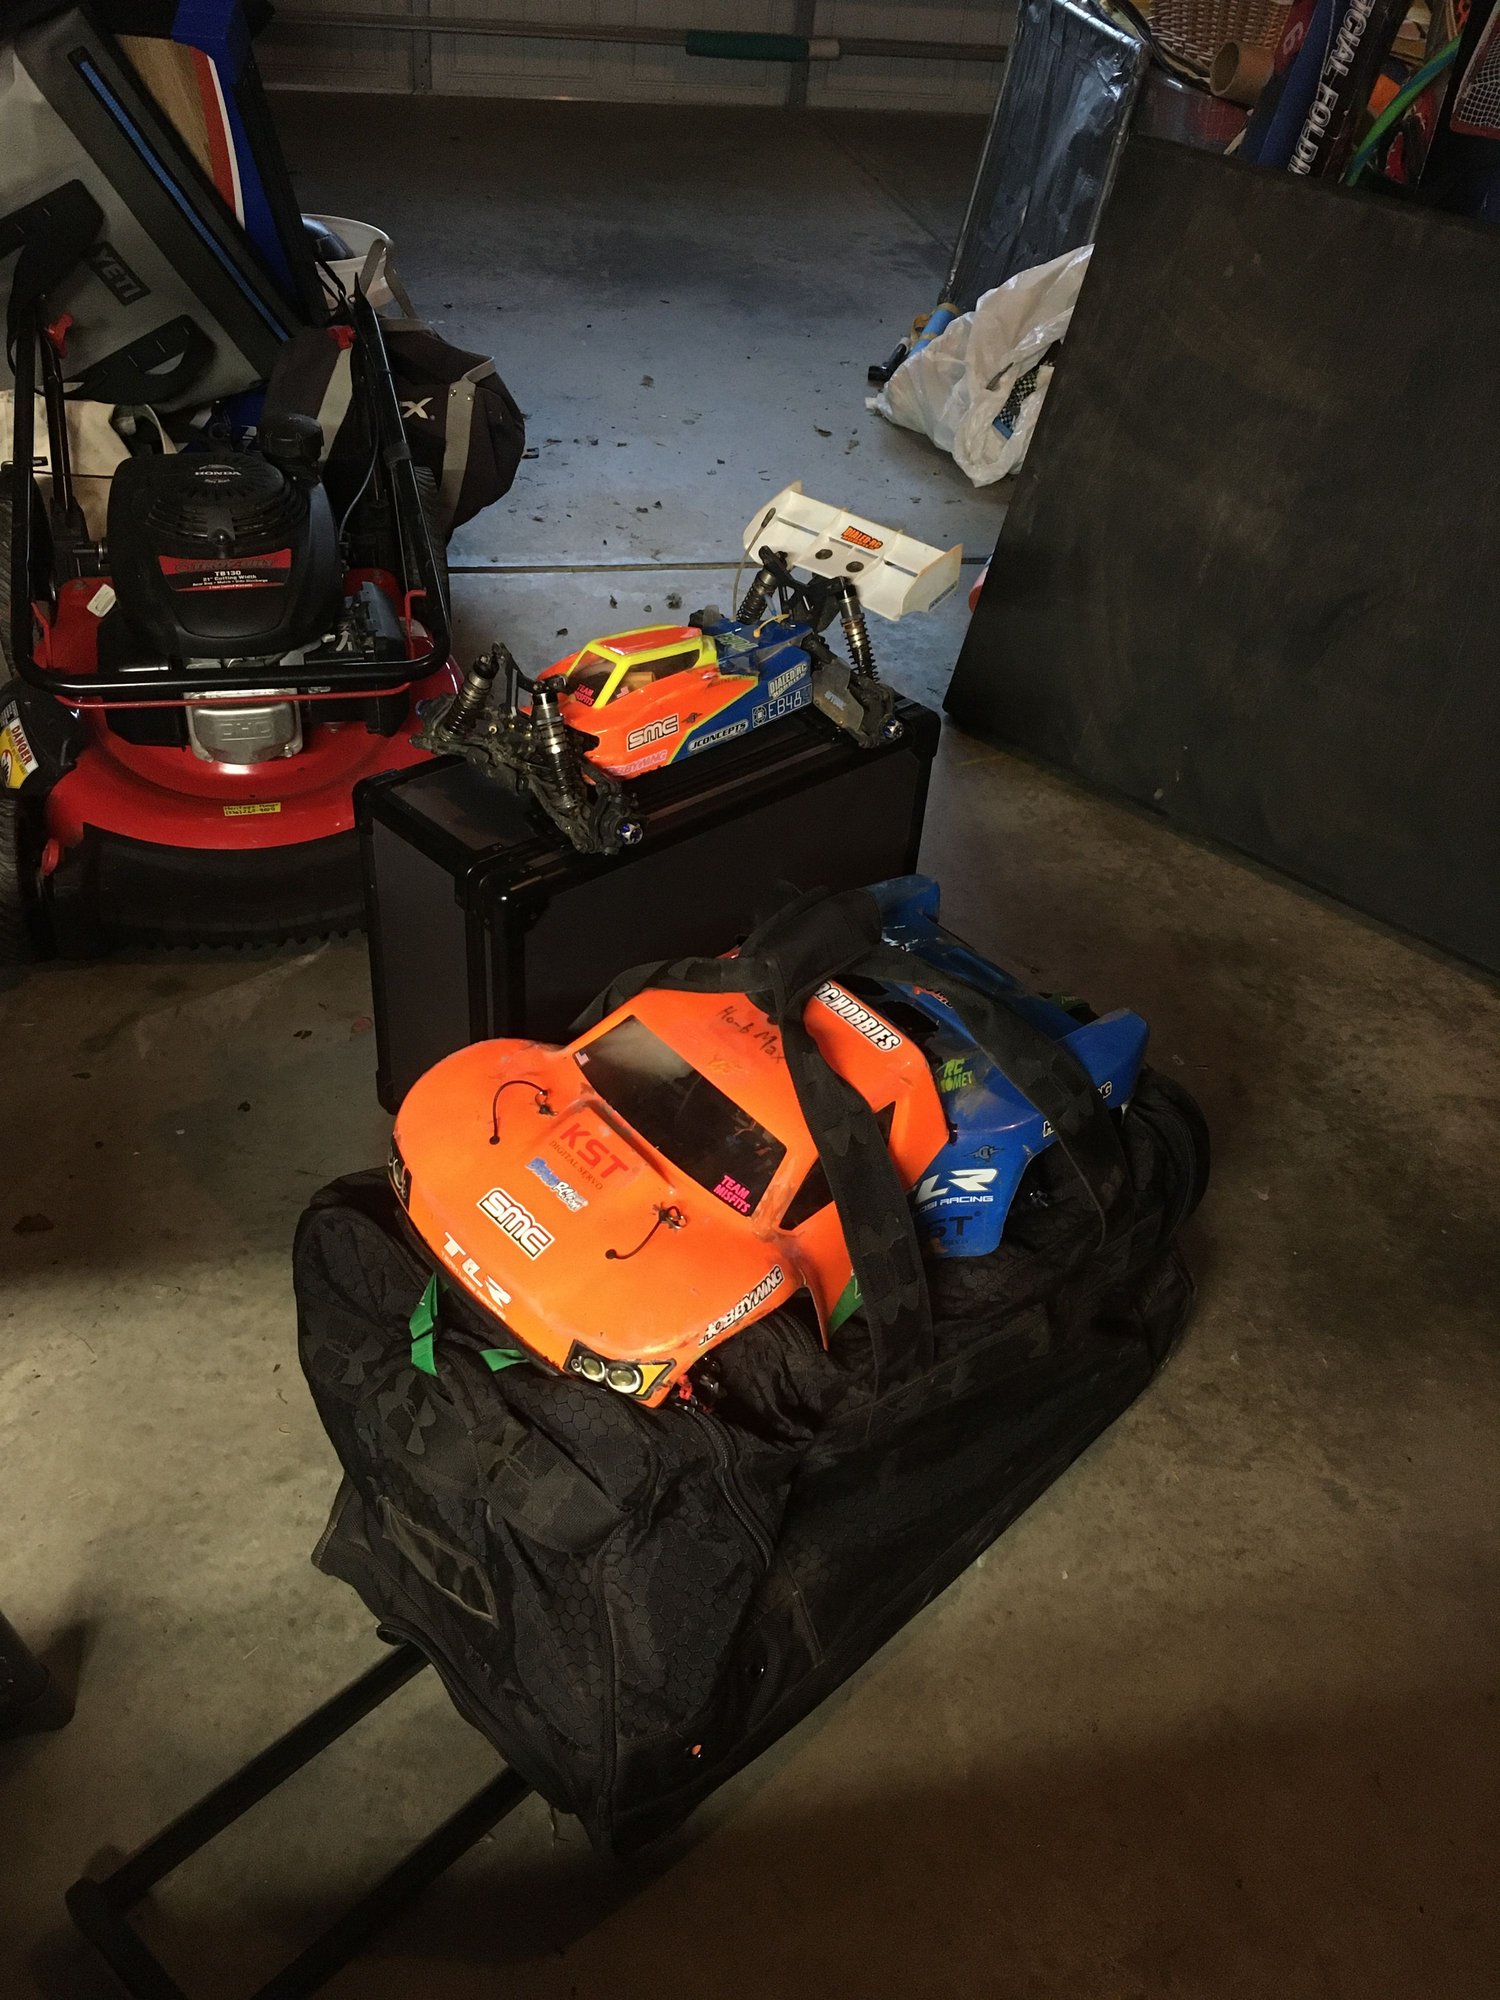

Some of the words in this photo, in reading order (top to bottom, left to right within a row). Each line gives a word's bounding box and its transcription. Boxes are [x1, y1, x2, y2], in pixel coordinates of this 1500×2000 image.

[93, 247, 142, 298] YETI
[11, 725, 33, 766] DANGER
[691, 721, 747, 750] JCONCEPTS
[549, 1139, 580, 1170] DIGITAL
[577, 1165, 604, 1192] SERVO
[560, 1122, 629, 1180] KST
[713, 1184, 752, 1214] MISFITS
[720, 1174, 750, 1200] TEAM
[911, 1167, 998, 1205] LR
[939, 1194, 994, 1207] RACING
[443, 1231, 512, 1309] TLR
[699, 1264, 785, 1346] HOBBYWING
